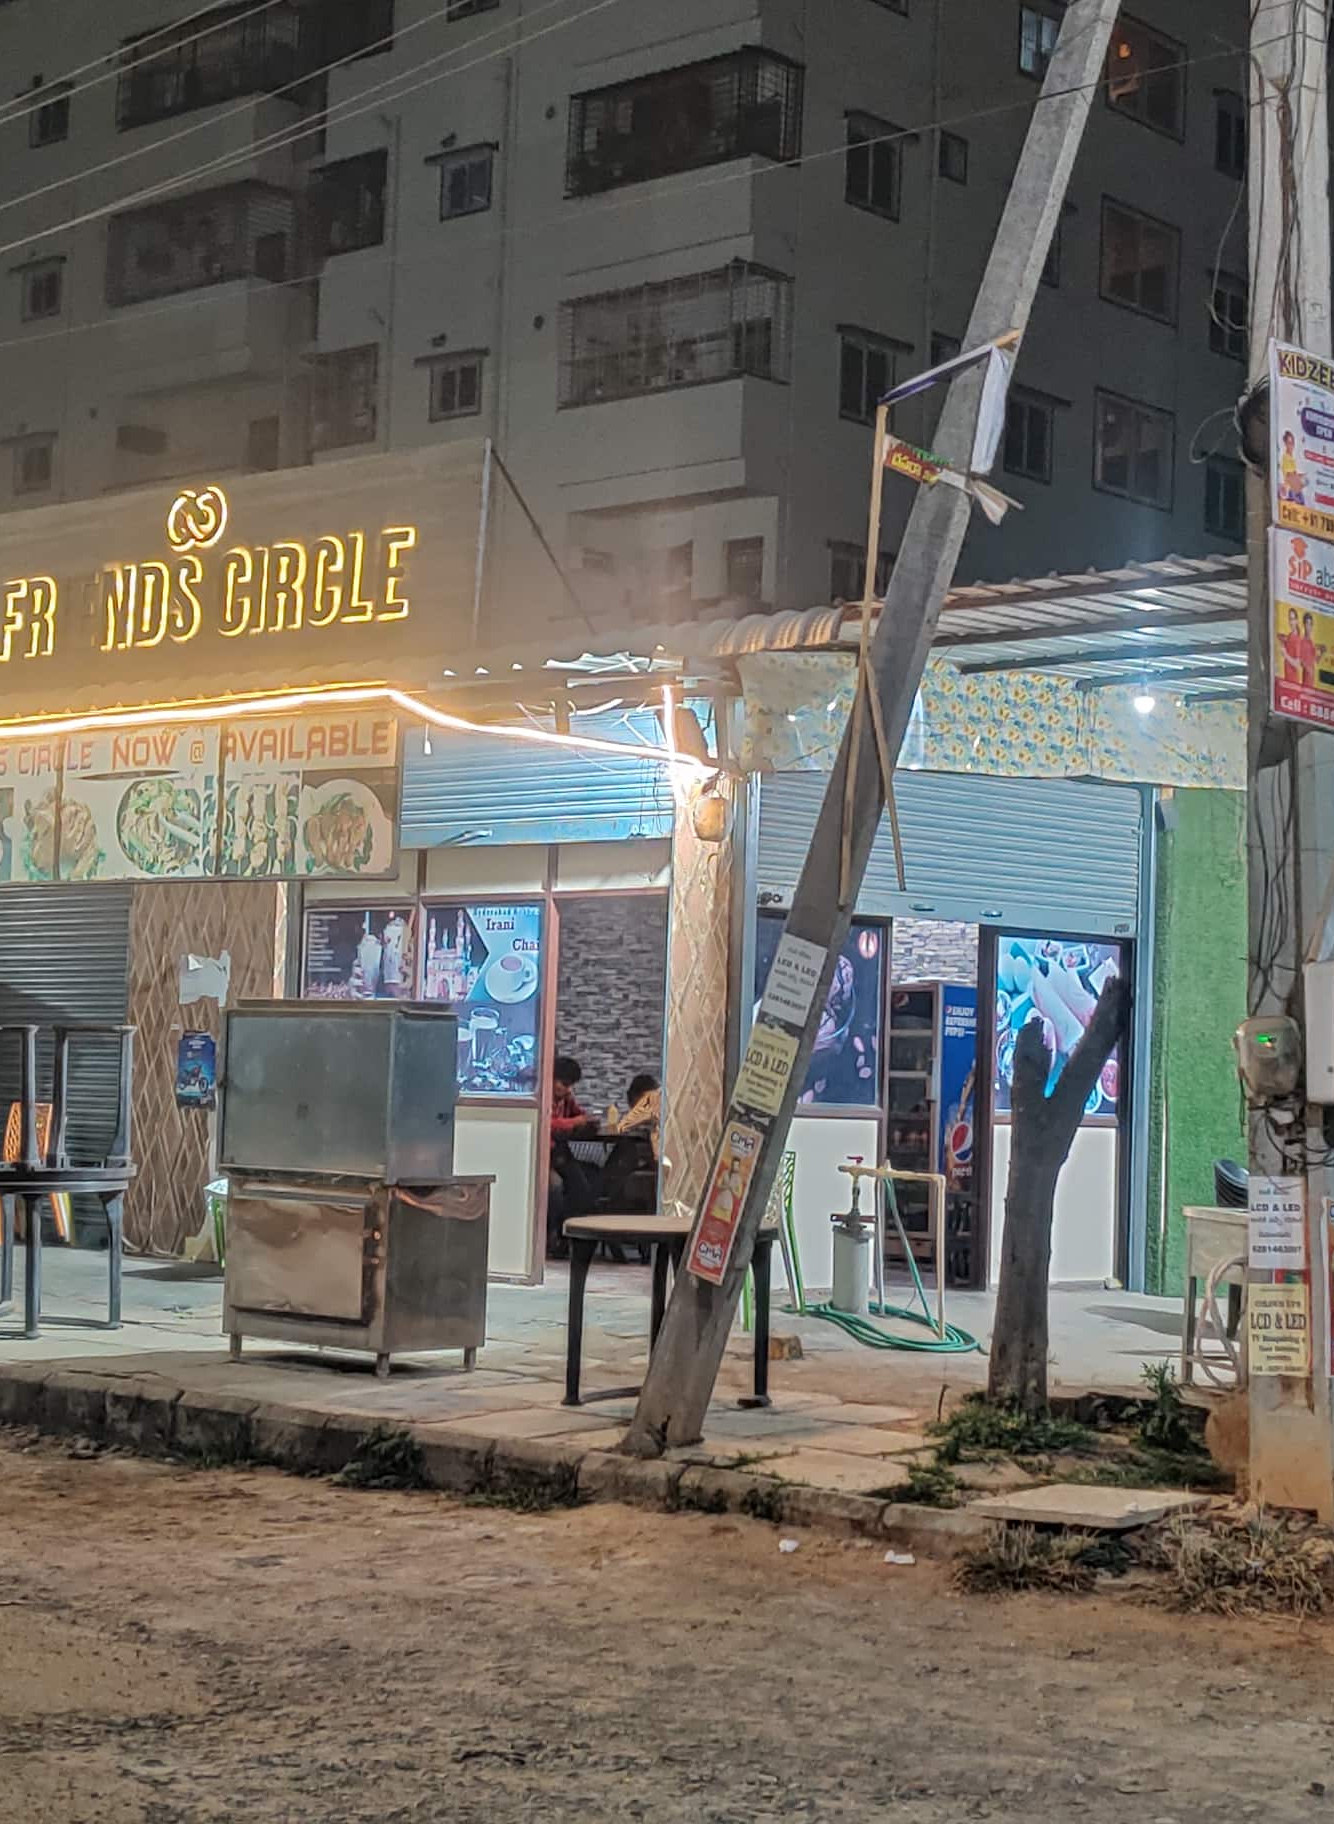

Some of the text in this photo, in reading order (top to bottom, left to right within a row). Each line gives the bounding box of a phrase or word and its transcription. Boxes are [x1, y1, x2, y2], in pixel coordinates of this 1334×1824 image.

[216, 525, 417, 637] CIRCLE
[111, 732, 178, 770] NOW
[222, 718, 390, 764] AVAILABLE
[485, 917, 515, 931] Irani
[770, 1057, 789, 1076] LED
[1251, 1203, 1269, 1212] LCD
[1283, 1203, 1300, 1212] LED
[1251, 1312, 1307, 1330] LCD & LED
